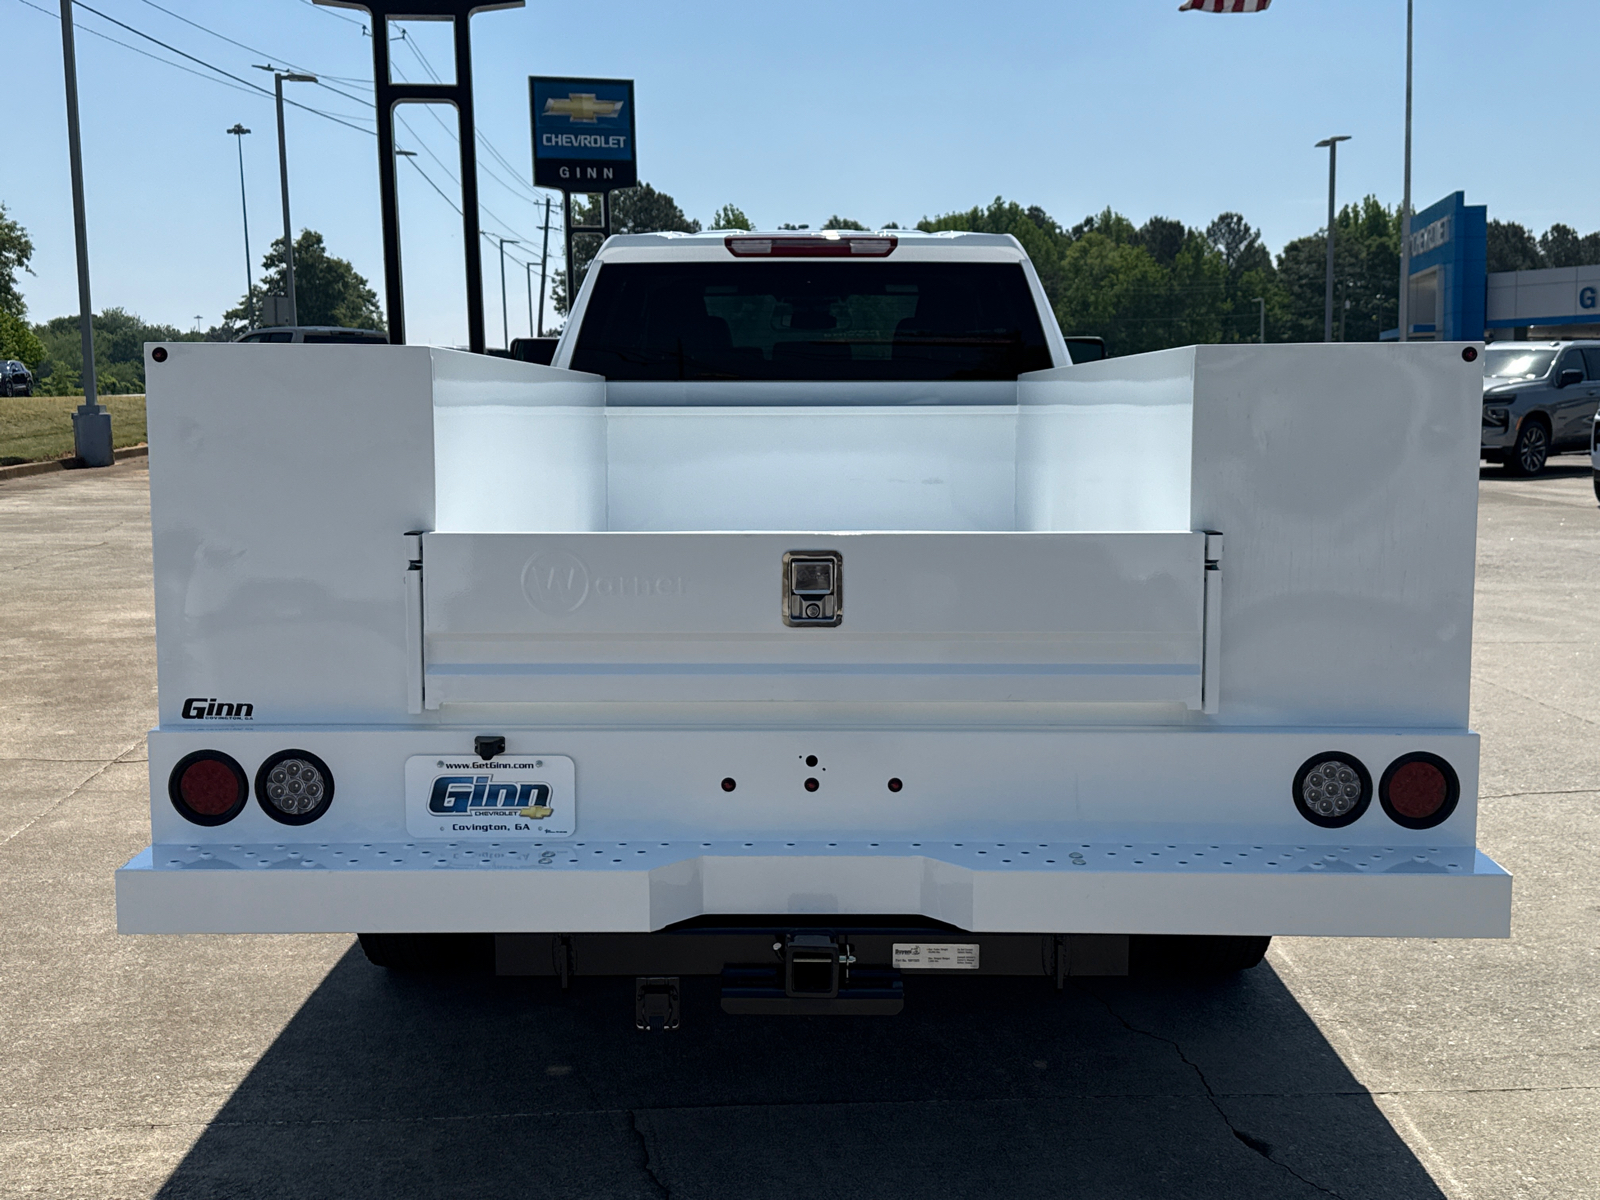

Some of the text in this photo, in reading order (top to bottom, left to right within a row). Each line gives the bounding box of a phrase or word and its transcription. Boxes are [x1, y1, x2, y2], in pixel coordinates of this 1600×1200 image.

[542, 133, 626, 149] CHEVROLET
[559, 166, 613, 179] GINN
[181, 697, 254, 720] Ginn
[445, 761, 534, 769] www.GetGinn.com
[427, 775, 551, 814] Ginn
[452, 823, 530, 832] Covington, GA
